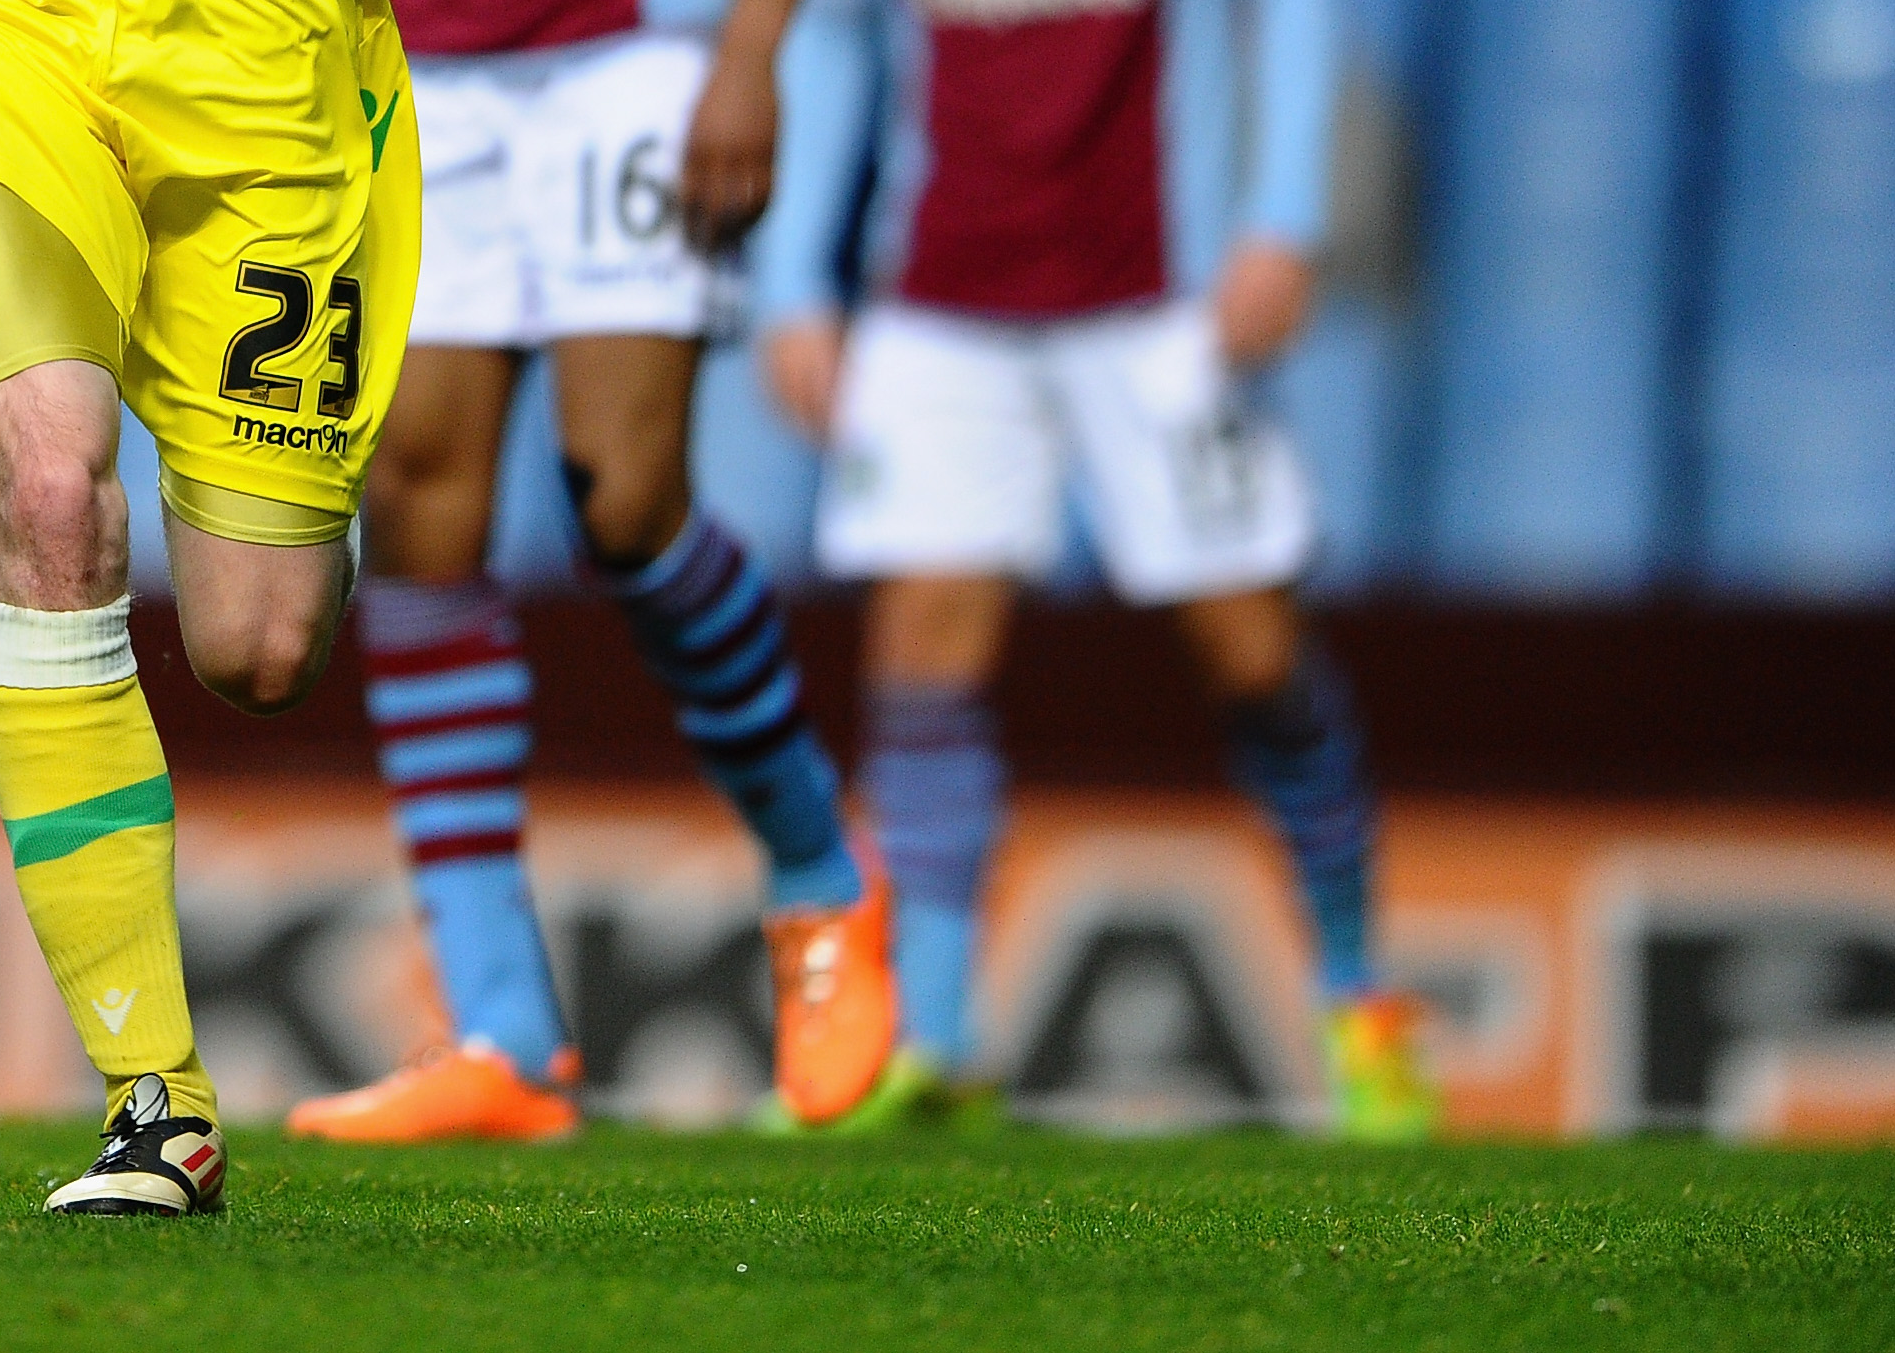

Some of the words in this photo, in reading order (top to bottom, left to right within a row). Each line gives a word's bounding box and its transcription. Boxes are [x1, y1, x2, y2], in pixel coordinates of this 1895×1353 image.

[578, 131, 679, 245] 16
[218, 259, 362, 421] 23
[232, 414, 348, 455] macron
